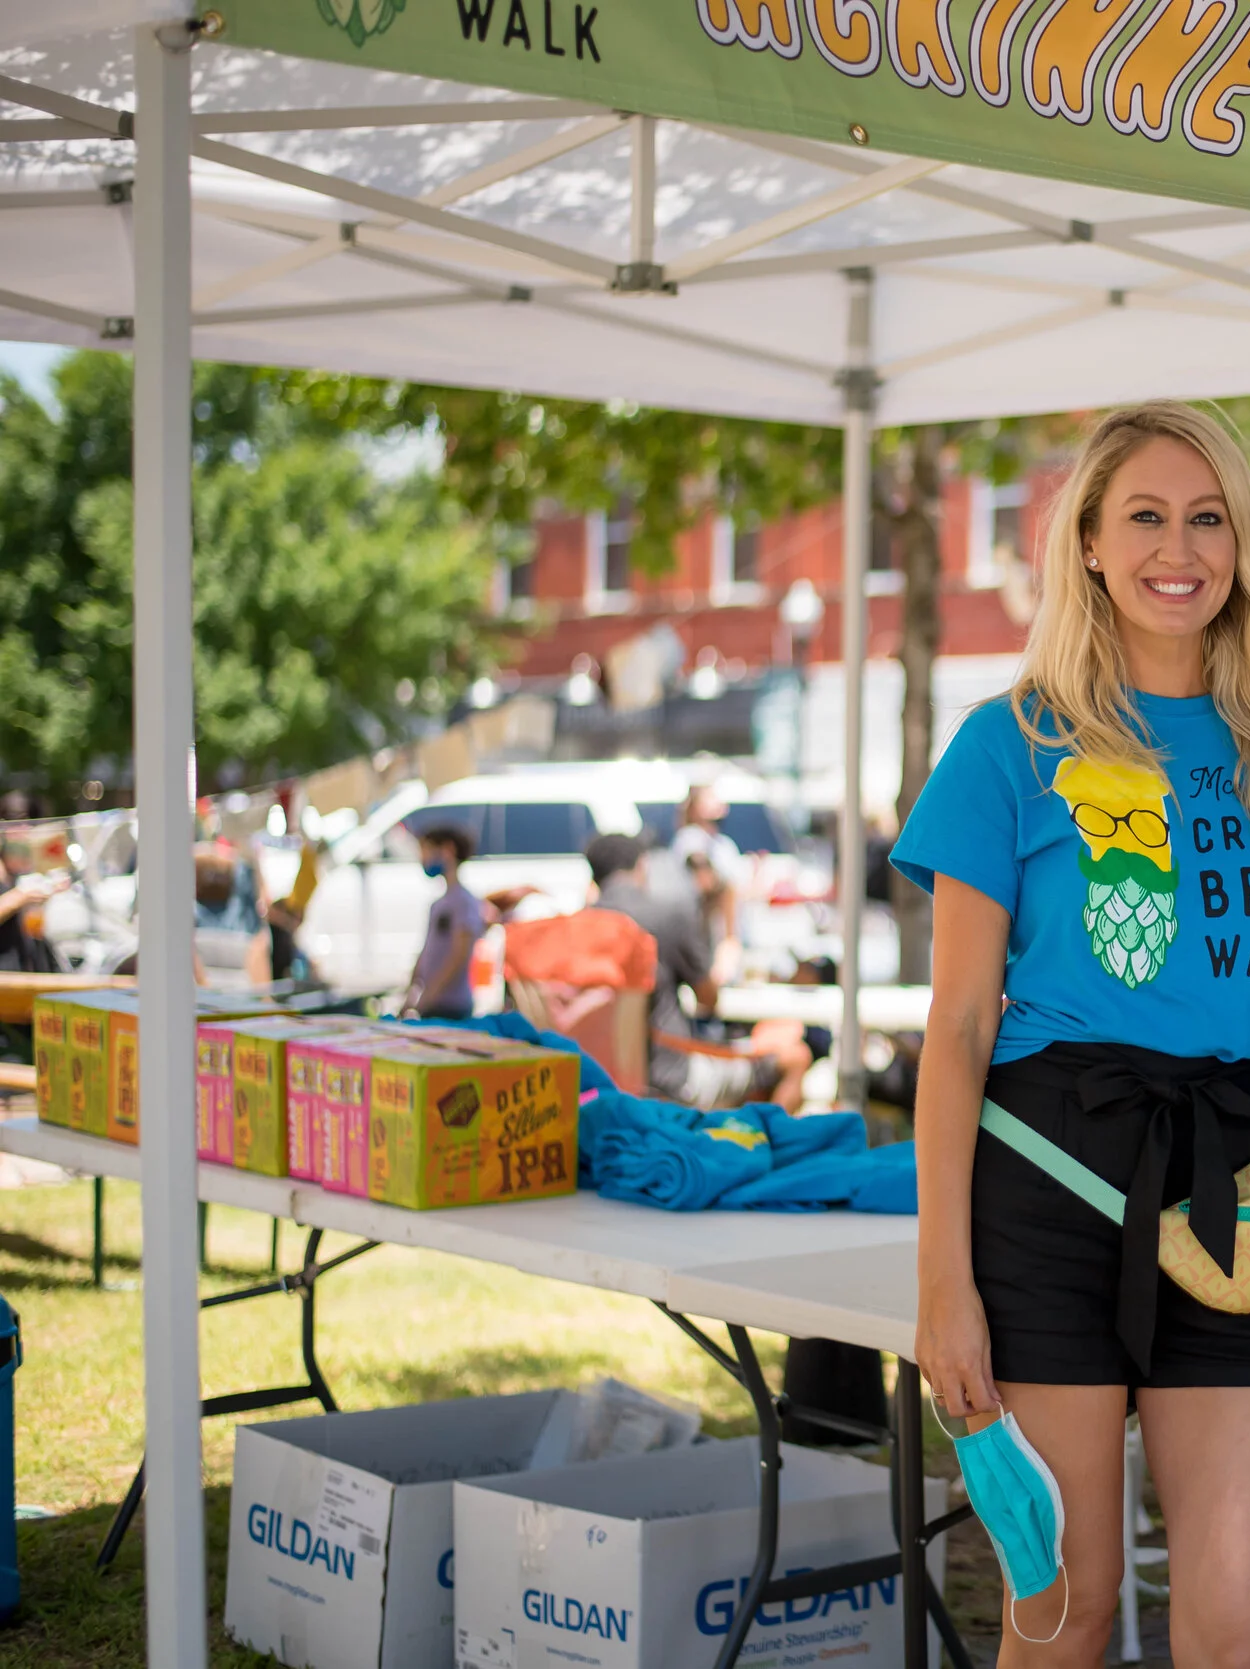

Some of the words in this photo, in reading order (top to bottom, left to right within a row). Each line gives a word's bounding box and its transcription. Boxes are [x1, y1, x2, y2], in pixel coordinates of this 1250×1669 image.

[456, 0, 601, 63] WALK
[496, 1067, 552, 1113] DEEP
[497, 1141, 568, 1194] IPA
[247, 1502, 355, 1581] GILDAN
[522, 1588, 628, 1643] GILDAN
